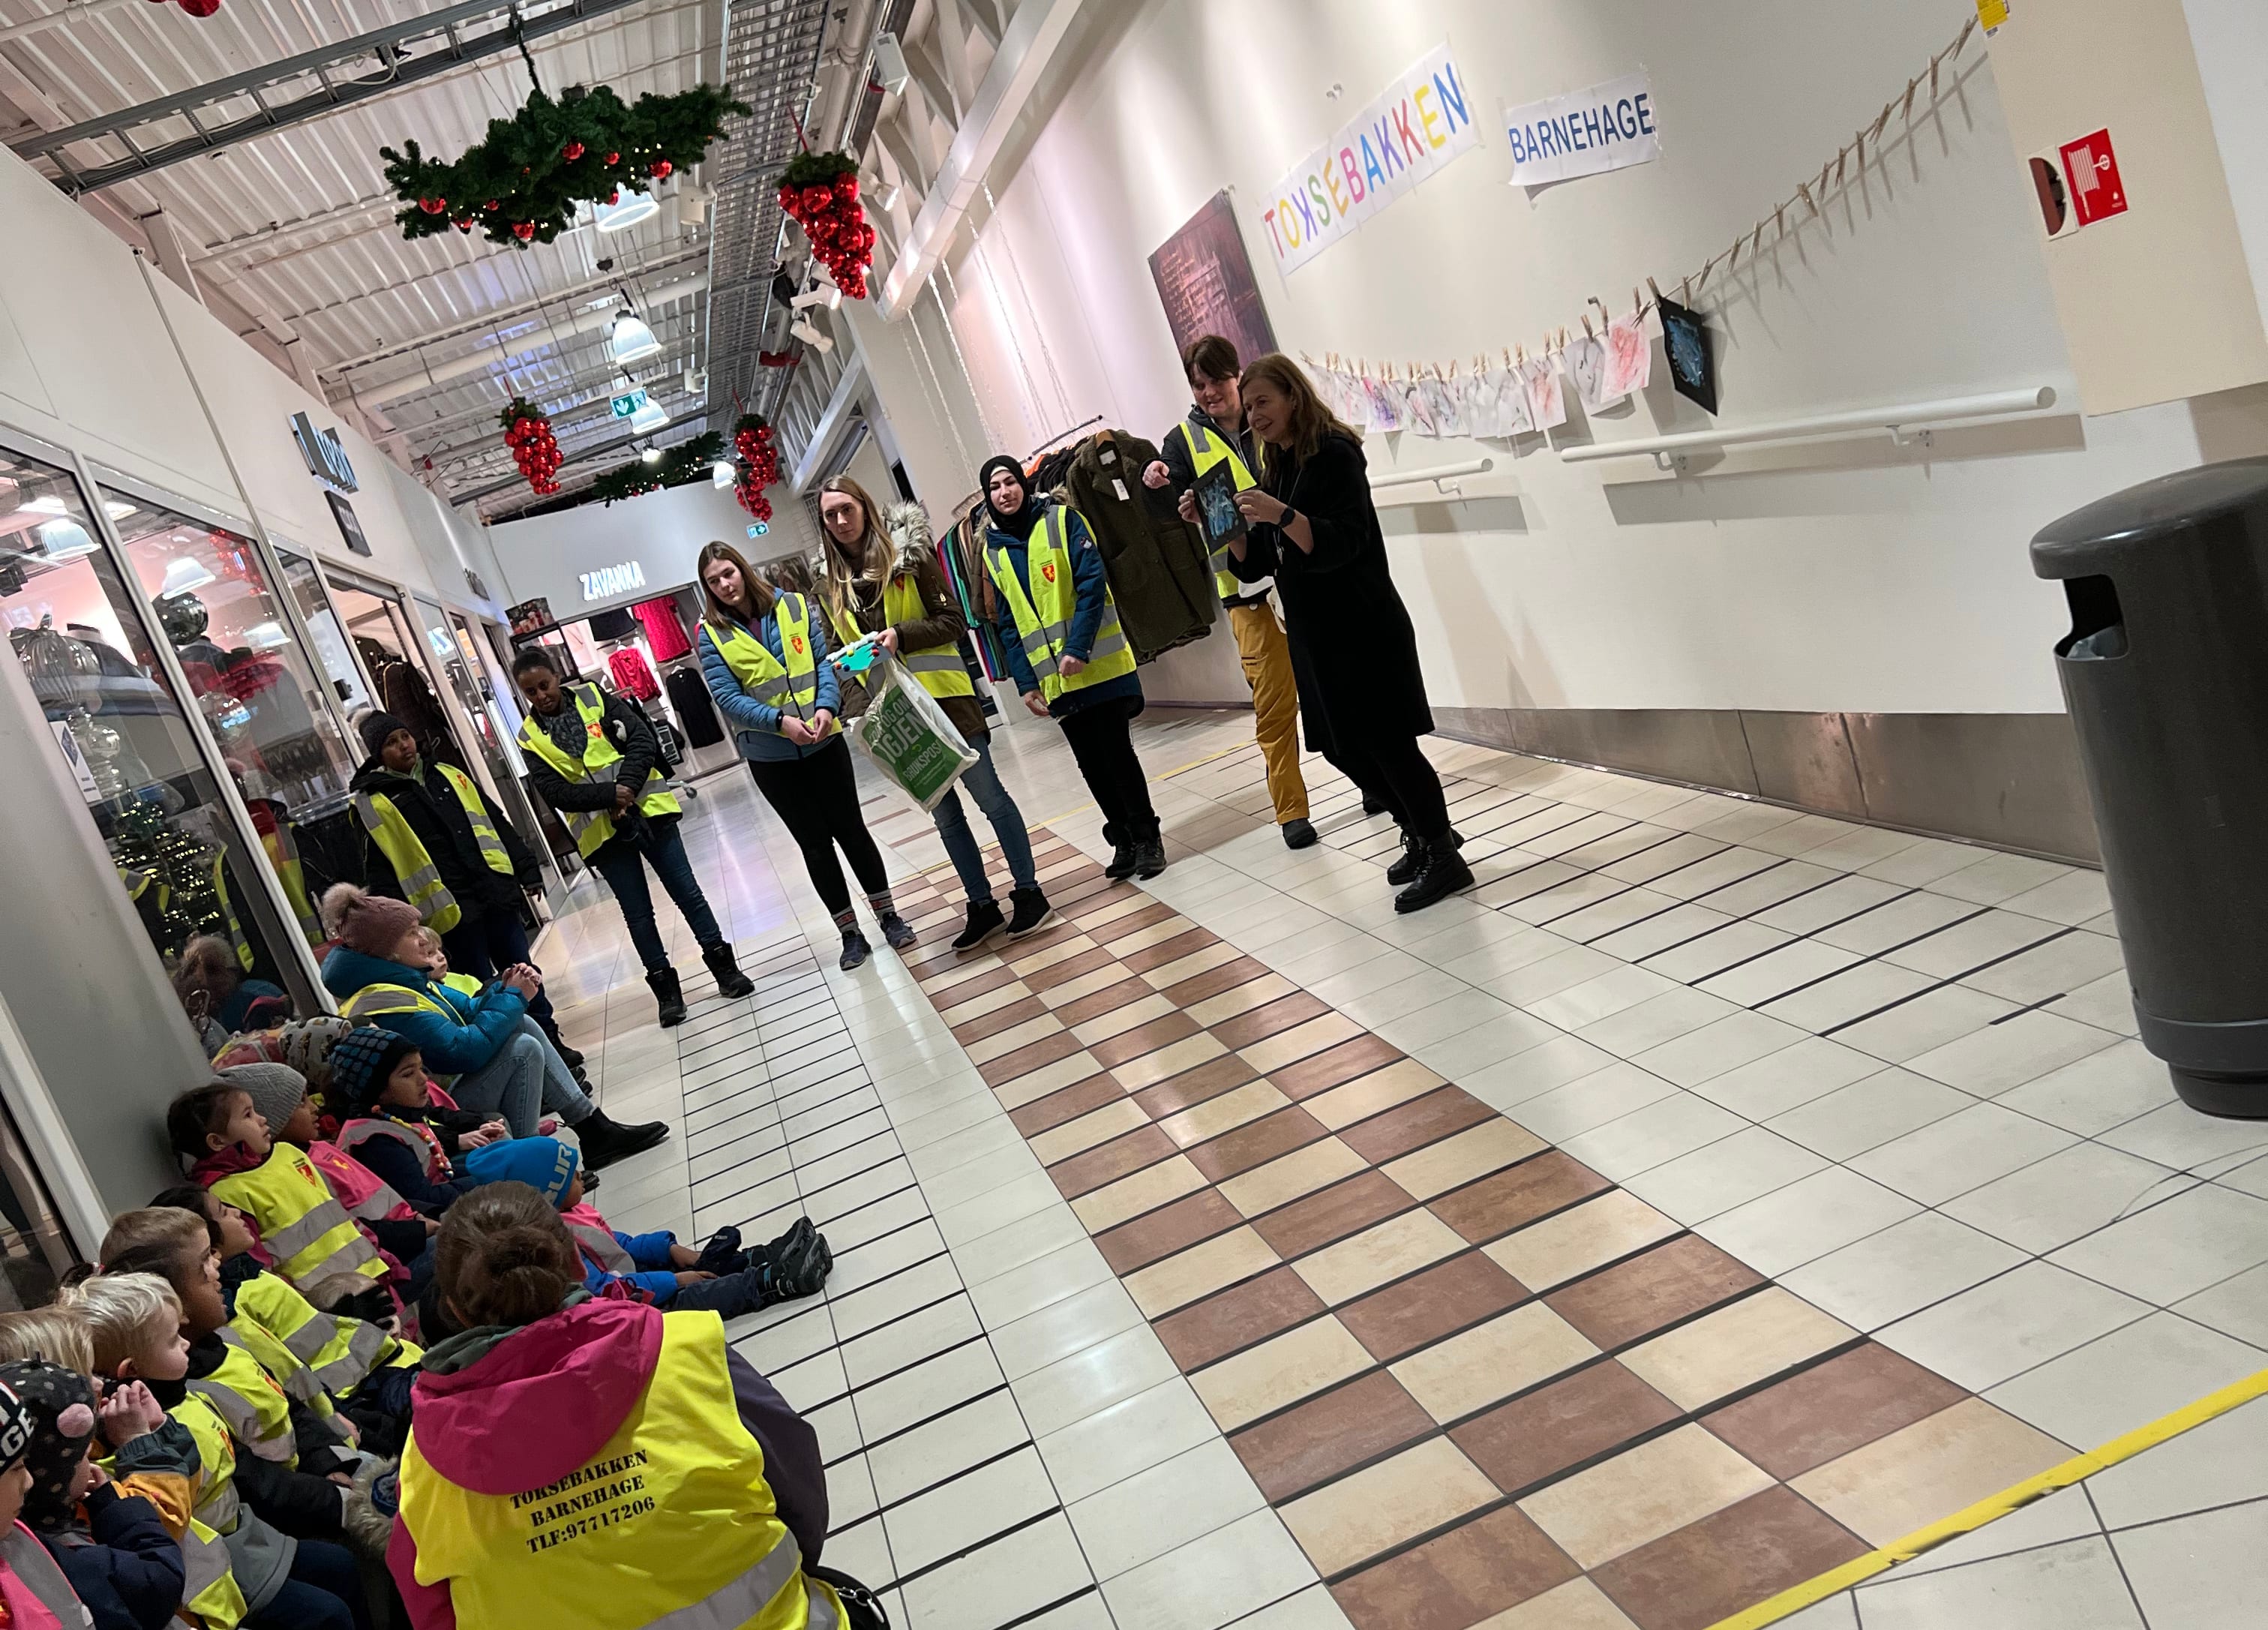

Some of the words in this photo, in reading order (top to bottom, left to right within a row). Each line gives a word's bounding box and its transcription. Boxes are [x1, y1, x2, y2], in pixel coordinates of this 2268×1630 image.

[1264, 62, 1469, 259] TOKSEBAKKEN
[1508, 92, 1654, 164] BARNEHAGE
[579, 560, 646, 601] ZAVANNA
[876, 707, 930, 764] IGJEN
[510, 1449, 649, 1509] TOKSEBAKKEN
[530, 1475, 645, 1527] BARNEHAGE
[526, 1496, 656, 1554] TLF:97717206
